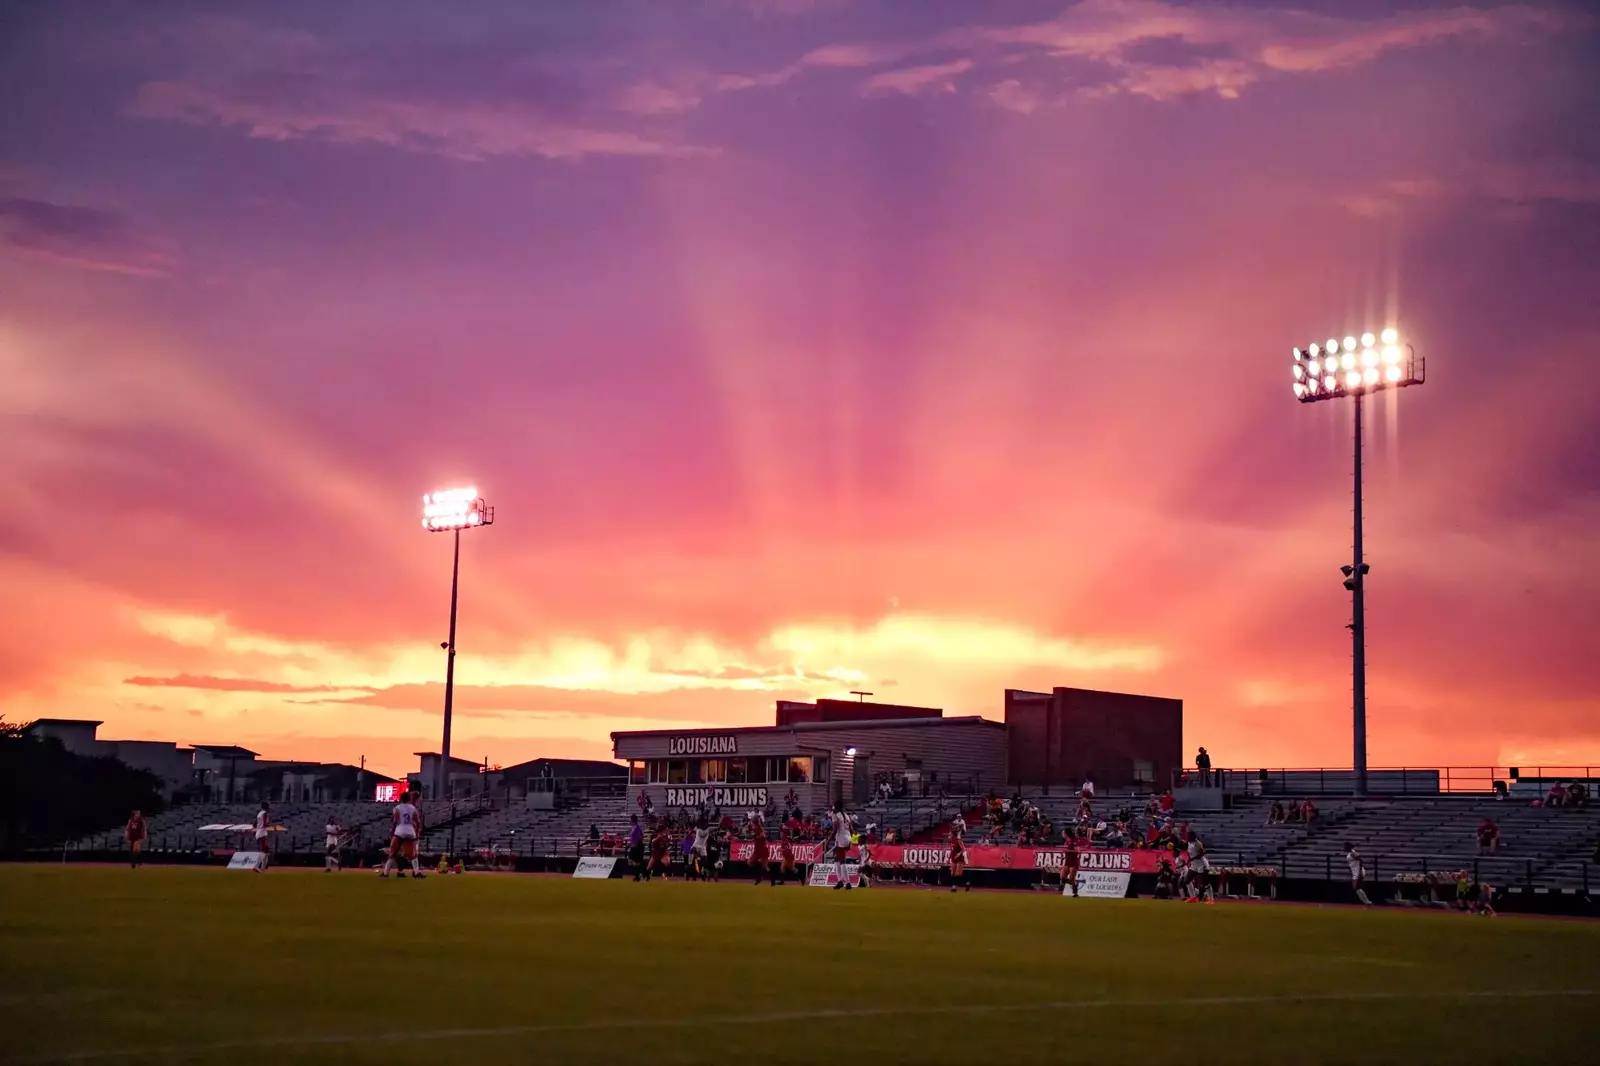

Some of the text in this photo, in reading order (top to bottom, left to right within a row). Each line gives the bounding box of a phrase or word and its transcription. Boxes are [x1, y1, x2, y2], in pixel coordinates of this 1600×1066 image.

[669, 736, 737, 754] LOUISIANA
[714, 788, 767, 806] CAJUNS
[1080, 853, 1130, 869] CAJUNS
